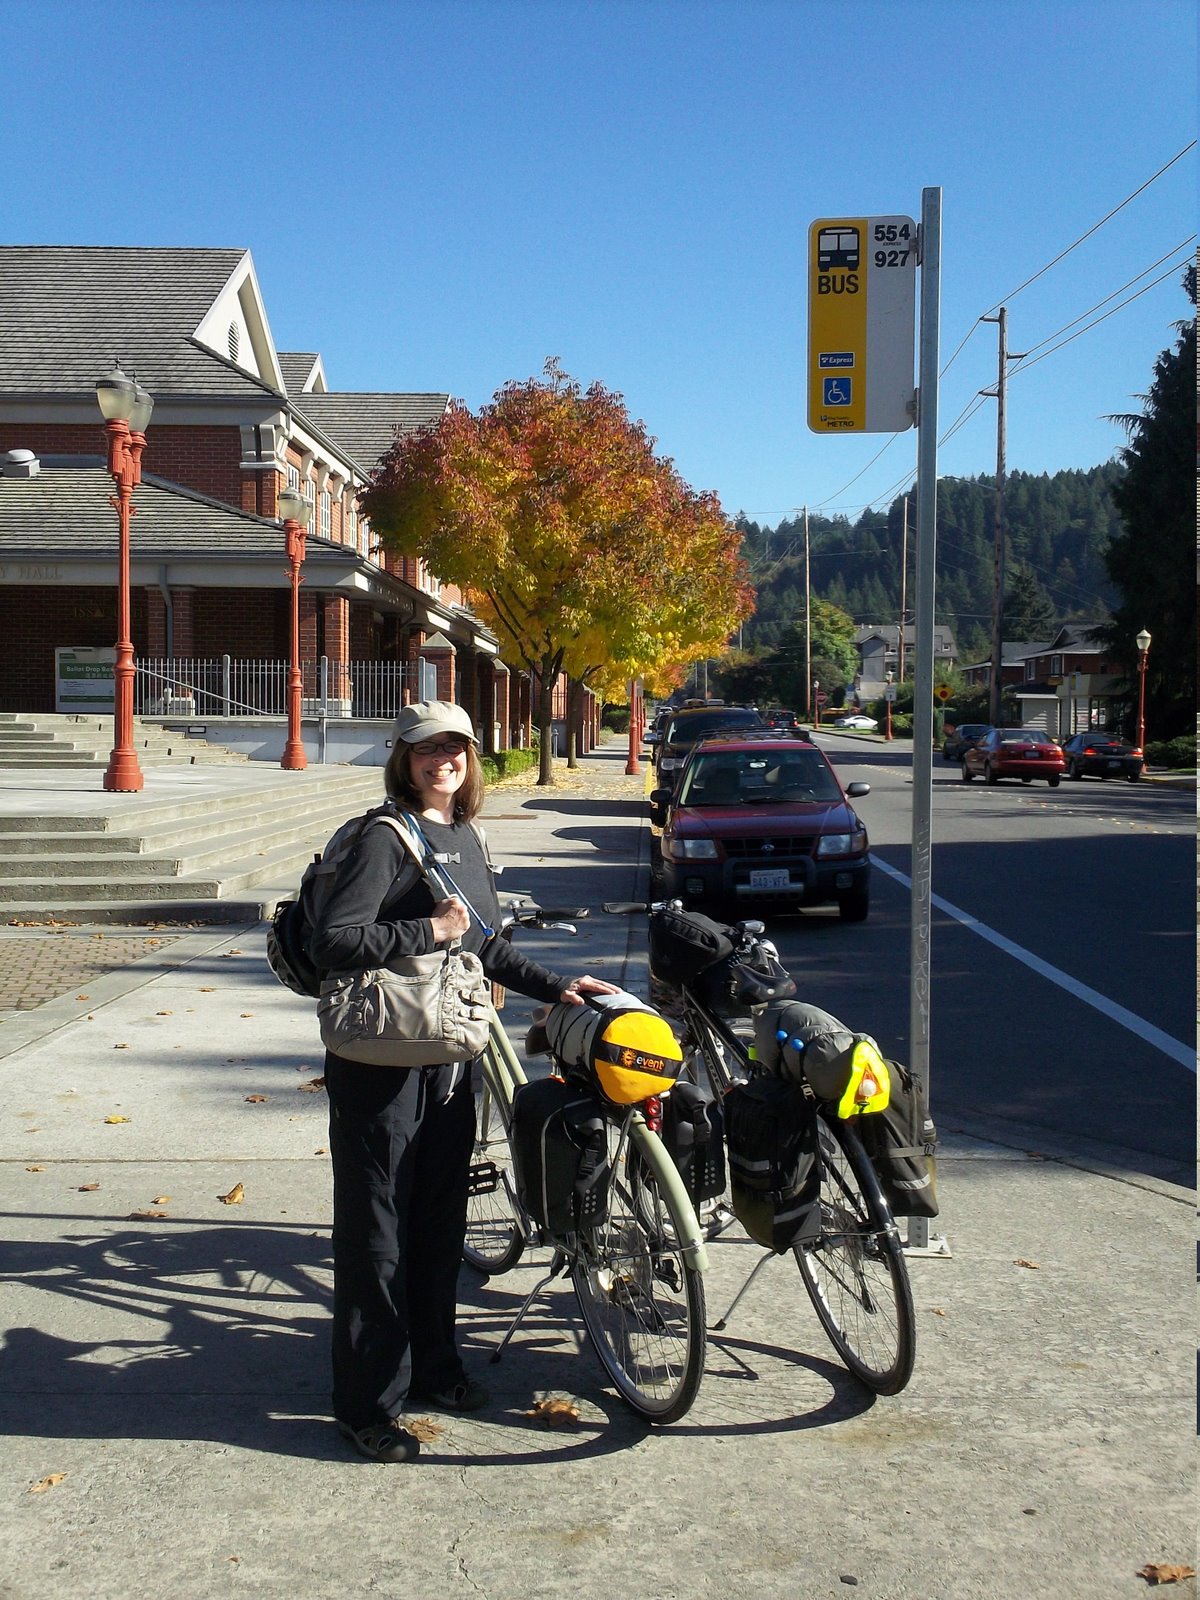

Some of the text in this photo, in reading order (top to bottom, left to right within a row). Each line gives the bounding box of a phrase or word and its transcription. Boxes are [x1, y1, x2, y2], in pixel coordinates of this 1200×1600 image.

[874, 223, 910, 242] 554
[874, 250, 910, 268] 927
[817, 274, 859, 295] BUS
[829, 356, 853, 364] Express
[20, 567, 62, 579] HALL
